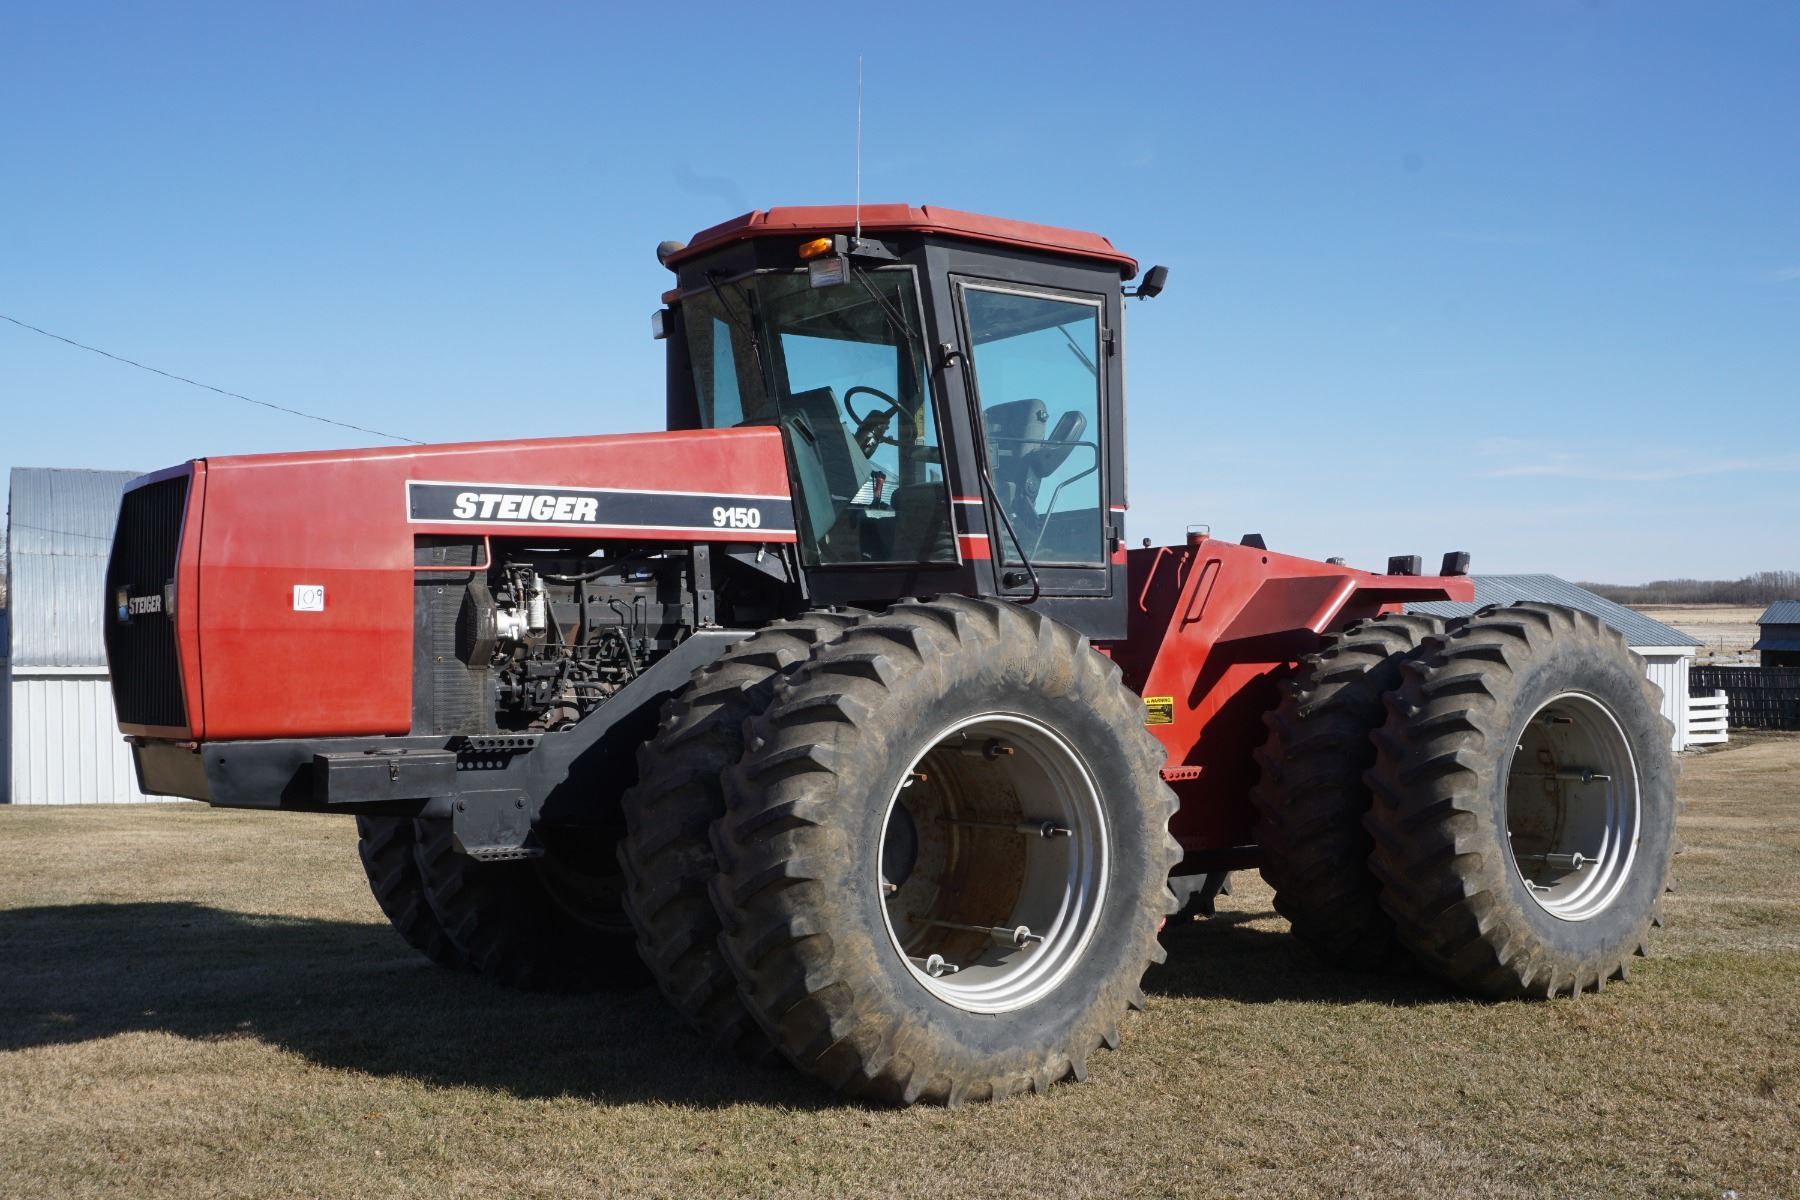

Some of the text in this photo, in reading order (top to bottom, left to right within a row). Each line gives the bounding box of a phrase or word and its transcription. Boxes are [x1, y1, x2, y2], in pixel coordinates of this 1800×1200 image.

[453, 492, 598, 522] STEIGER
[712, 506, 761, 528] 9150
[128, 594, 161, 615] STEIGER
[297, 587, 322, 606] 109
